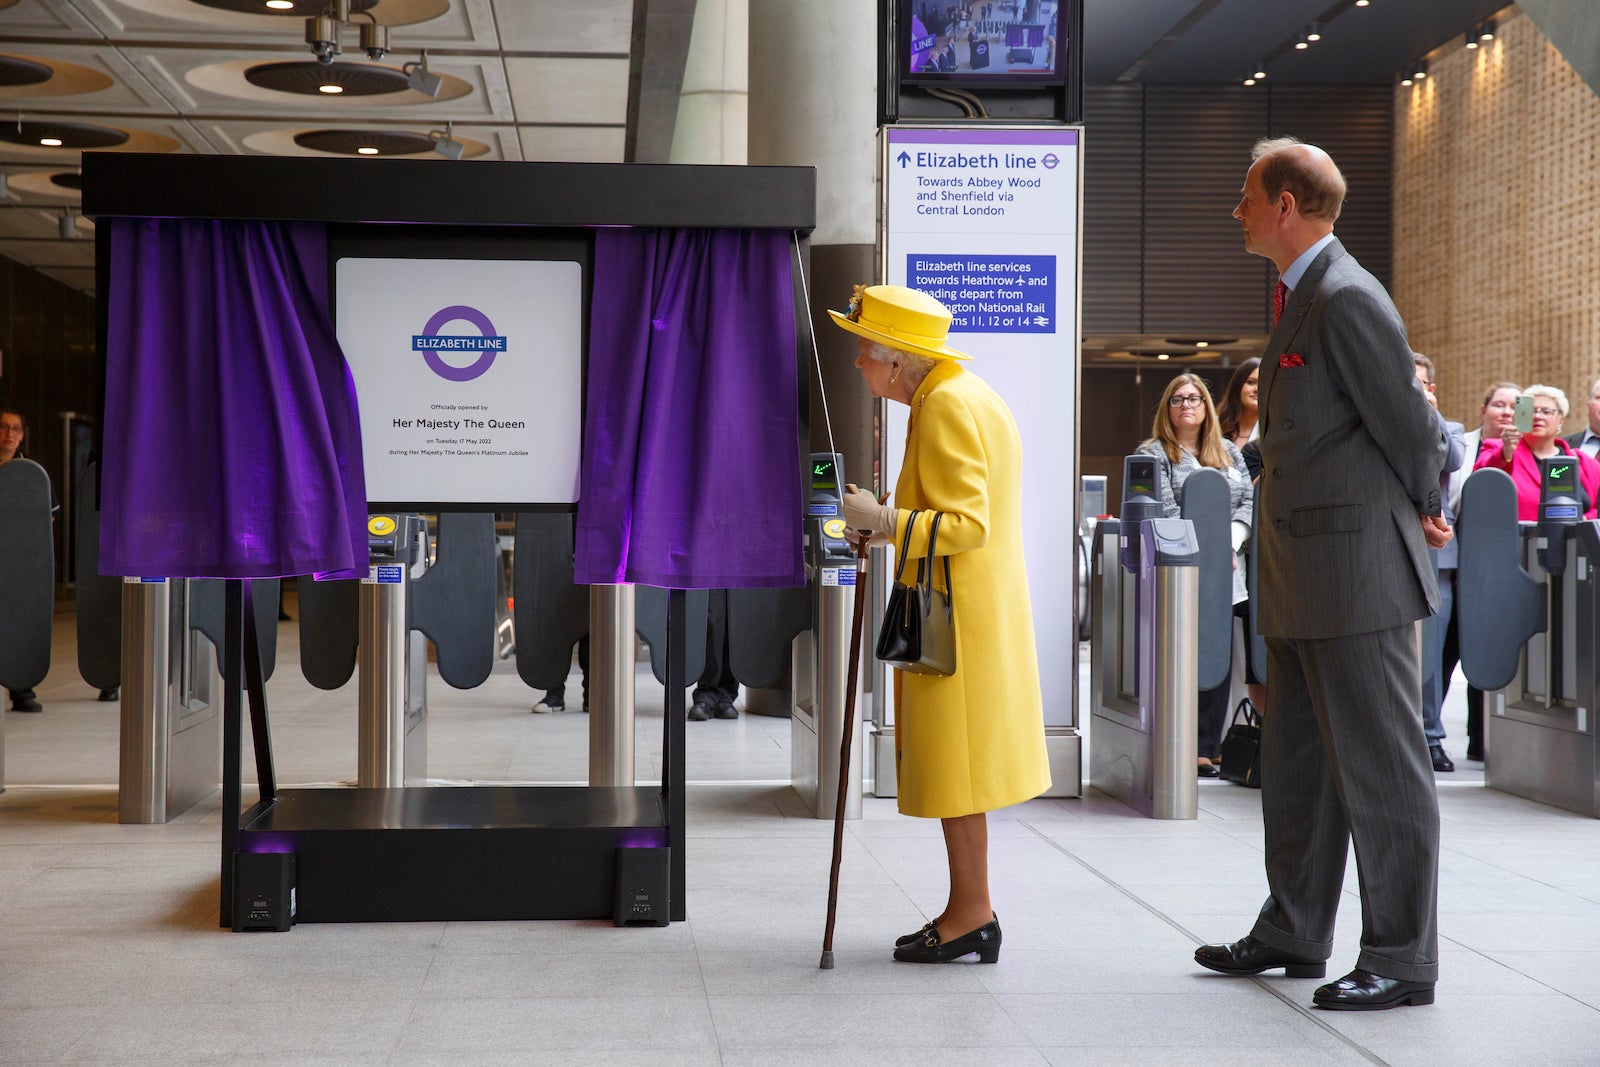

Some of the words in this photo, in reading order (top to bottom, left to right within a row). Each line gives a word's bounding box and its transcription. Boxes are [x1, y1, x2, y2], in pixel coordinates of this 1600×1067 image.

[914, 37, 933, 51] LINE
[917, 152, 998, 168] Elizabeth
[1005, 154, 1037, 169] line
[917, 176, 963, 187] Towards
[967, 177, 1003, 189] Abbey
[1007, 177, 1041, 188] Wood
[916, 190, 937, 201] and
[941, 190, 994, 202] Shenfield
[998, 191, 1014, 202] via
[916, 204, 959, 215] Central
[963, 204, 1005, 216] London
[915, 260, 964, 272] Elizabeth
[967, 261, 987, 272] line
[988, 262, 1032, 273] services
[915, 274, 959, 286] towards
[962, 275, 1014, 287] Heathrow
[1028, 275, 1048, 286] and
[959, 288, 994, 301] depart
[996, 289, 1024, 300] from
[978, 302, 1024, 313] National
[1026, 302, 1046, 314] Rail
[988, 316, 1000, 327] 12
[1003, 317, 1015, 327] or
[1018, 316, 1030, 327] 14
[416, 338, 475, 349] ELIZABETH
[477, 339, 503, 349] LINE
[392, 418, 413, 428] Her
[416, 418, 460, 431] Majesty
[463, 418, 484, 429] The
[487, 419, 525, 430] Queen
[388, 449, 408, 457] during
[421, 449, 443, 457] Majesty
